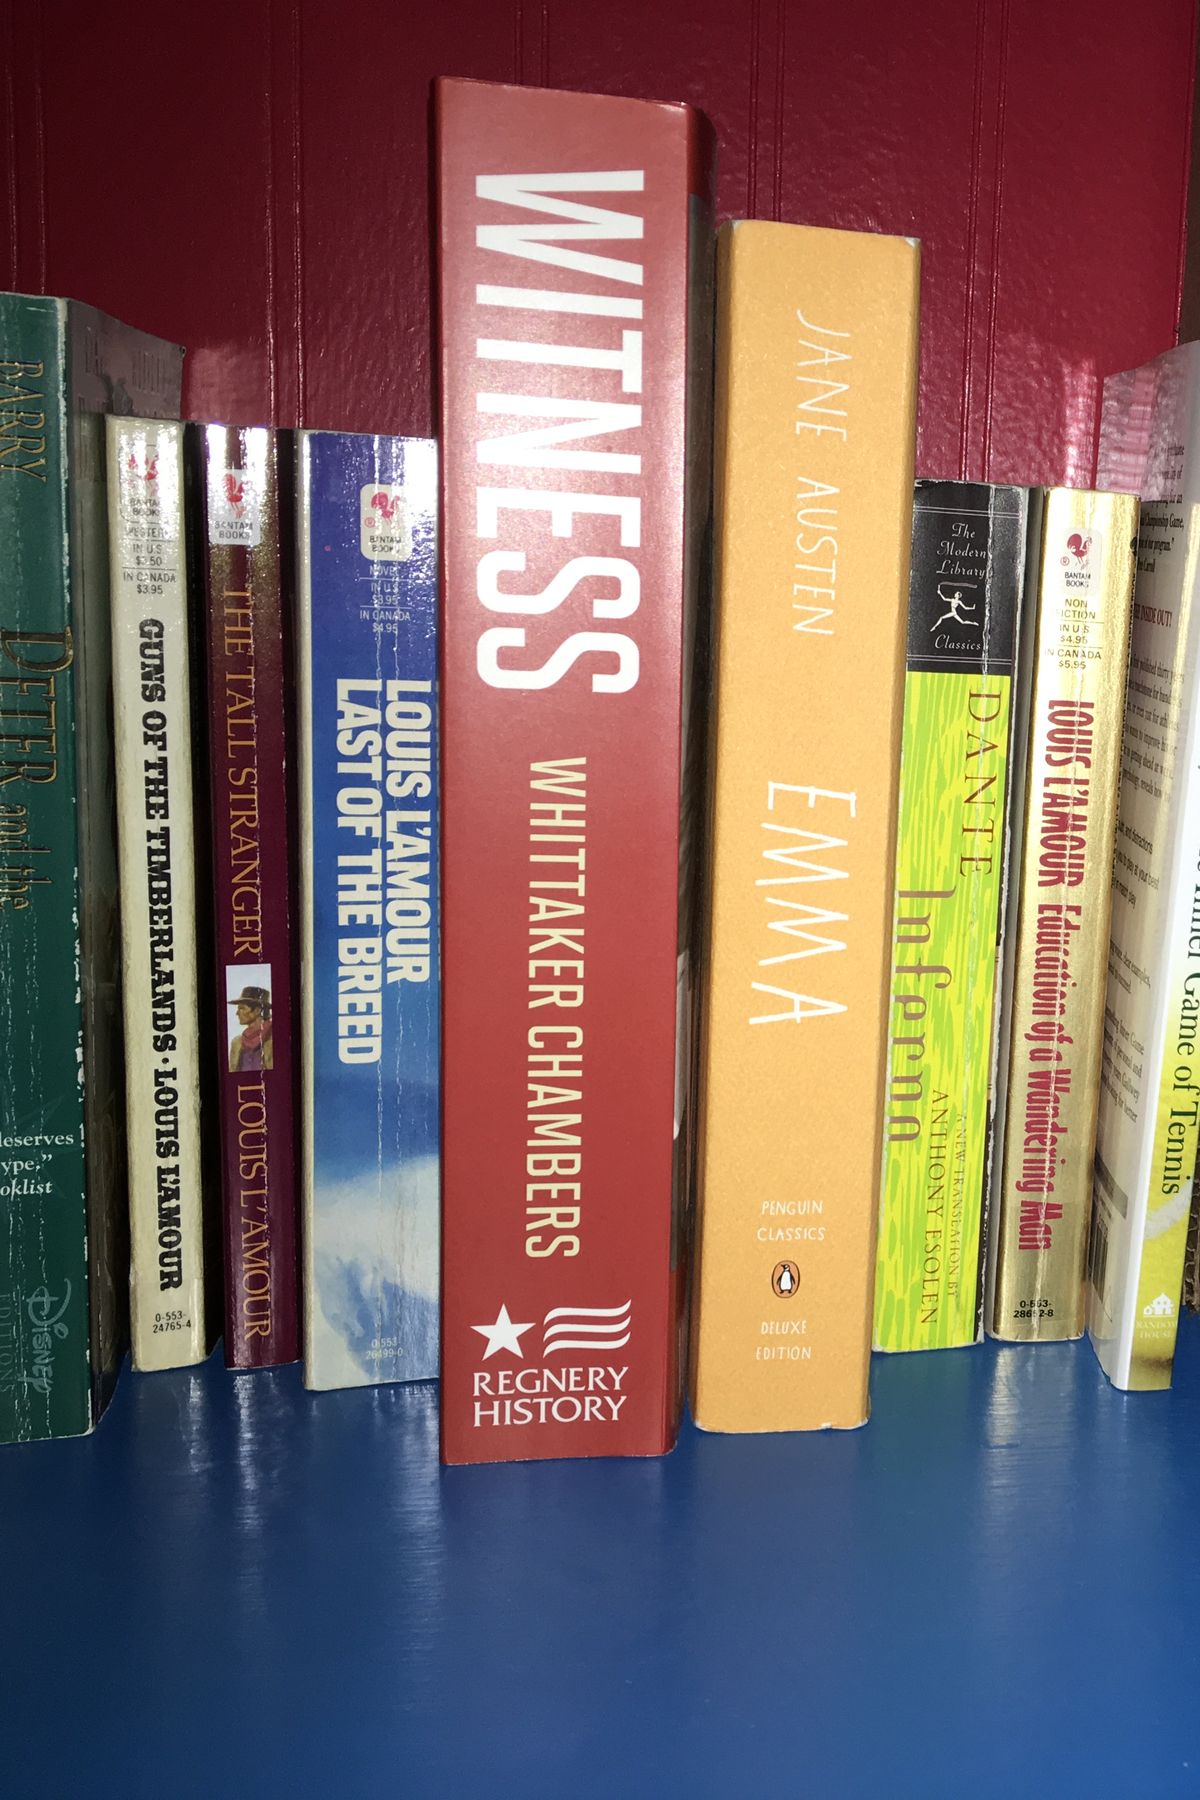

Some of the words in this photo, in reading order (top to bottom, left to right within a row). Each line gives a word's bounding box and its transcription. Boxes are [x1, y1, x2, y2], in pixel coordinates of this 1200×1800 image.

[795, 308, 853, 443] JANE
[0, 360, 47, 482] BARRY
[476, 170, 644, 694] WITNESS
[218, 531, 250, 540] BOOKS
[791, 476, 841, 636] AUSTEN
[936, 540, 987, 559] Modern
[951, 522, 976, 539] The
[123, 571, 133, 582] IN
[136, 571, 176, 583] CANADA
[936, 560, 986, 579] Library
[1064, 571, 1091, 580] BANTAM
[1065, 580, 1089, 588] BOOKS
[223, 584, 254, 656] THE
[359, 610, 369, 621] IN
[372, 610, 411, 621] CANADA
[1056, 609, 1096, 620] ICTION
[1060, 624, 1069, 632] IN
[1065, 598, 1088, 608] NON
[139, 618, 167, 703] GUNS
[934, 634, 982, 650] Classics
[1057, 648, 1102, 660] CANADA
[1059, 660, 1087, 670] $5.95
[1060, 635, 1088, 644] $4.95
[0, 626, 74, 784] PETER
[142, 710, 167, 751] OF
[225, 666, 257, 758] TALL
[336, 678, 383, 781] LAST
[1045, 700, 1095, 769] LOUIS
[385, 679, 432, 798] LOUIS
[144, 757, 170, 820] THE
[336, 787, 383, 838] OF
[959, 690, 1002, 877] DANTE
[228, 767, 262, 957] STRANGER
[1037, 777, 1090, 887] L'AMOUR
[337, 848, 383, 926] THE
[385, 810, 432, 985] L'AMOUR
[527, 757, 587, 1010] WHITTAKER
[749, 780, 857, 1025] EMMA
[146, 826, 177, 1052] TIMBERLANDS
[1031, 904, 1082, 1016] Education
[337, 937, 383, 1064] BREED
[1024, 1021, 1074, 1044] of
[1029, 1047, 1063, 1062] a
[1173, 1065, 1200, 1097] of
[0, 1131, 74, 1147] eserves
[154, 1067, 180, 1159] LOUIS
[236, 1083, 268, 1180] LOUIS
[525, 1025, 585, 1259] CHAMBERS
[954, 1127, 967, 1162] NEW
[1015, 1068, 1072, 1193] Wandering
[926, 1089, 949, 1219] ANTHONY
[1161, 1099, 1199, 1196] Tennis
[156, 1164, 183, 1291] L'AMOUR
[757, 1227, 826, 1241] CLASSICS
[761, 1200, 824, 1216] PENGUIN
[948, 1168, 965, 1276] TRANSLATION
[1018, 1200, 1064, 1250] Man
[239, 1189, 272, 1340] L'AMOUR
[921, 1230, 942, 1324] ESOLEN
[947, 1281, 959, 1297] BY
[152, 1319, 192, 1334] 24765-4
[755, 1346, 812, 1361] EDITION
[761, 1320, 807, 1335] DELUXE
[472, 1366, 629, 1396] REGNERY
[473, 1396, 627, 1427] HISTORY
